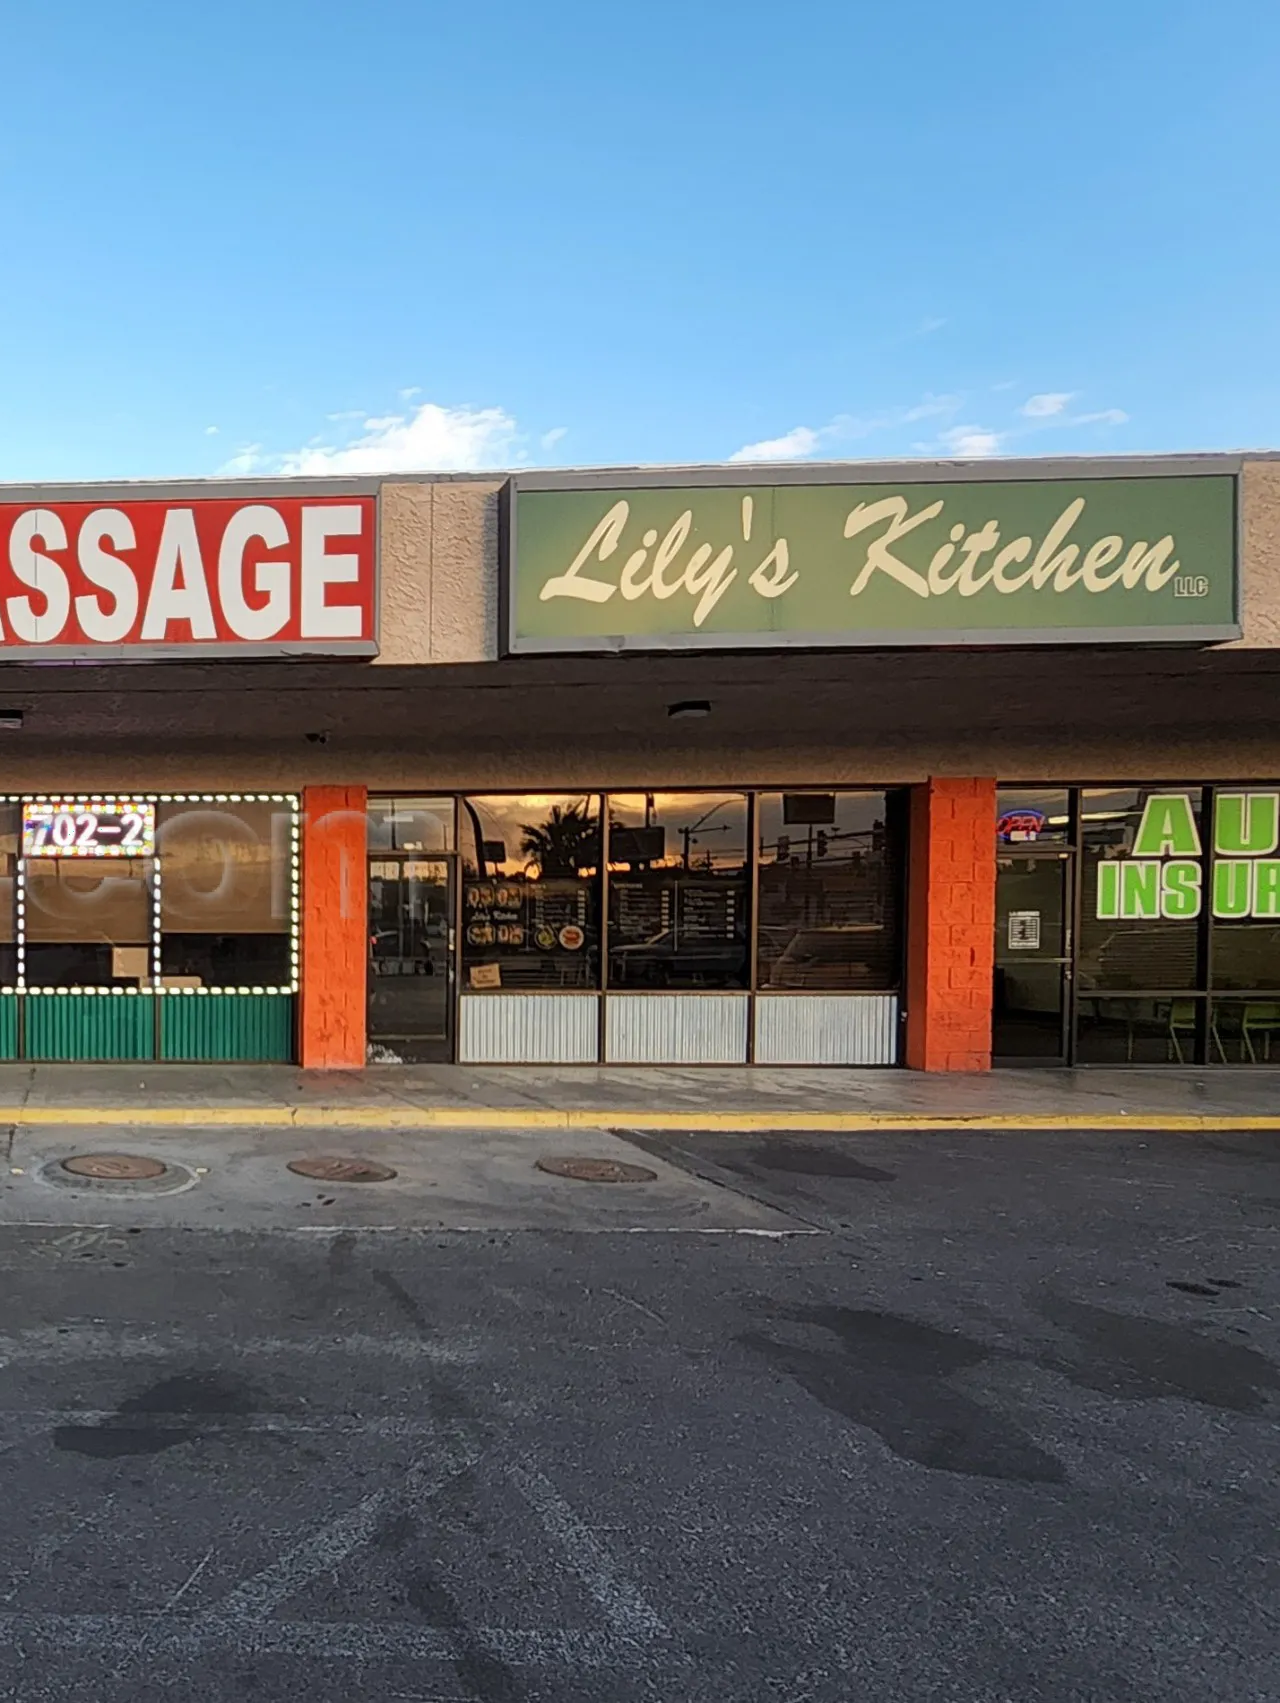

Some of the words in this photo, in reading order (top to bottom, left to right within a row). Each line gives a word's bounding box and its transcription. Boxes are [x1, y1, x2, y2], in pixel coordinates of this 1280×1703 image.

[539, 495, 800, 628] Lily's
[843, 495, 1180, 600] Kitchen
[1174, 575, 1209, 598] LLC
[30, 812, 144, 848] 702-2
[997, 815, 1045, 834] OPEN
[1132, 793, 1280, 856] AU
[1096, 859, 1280, 920] INSUR
